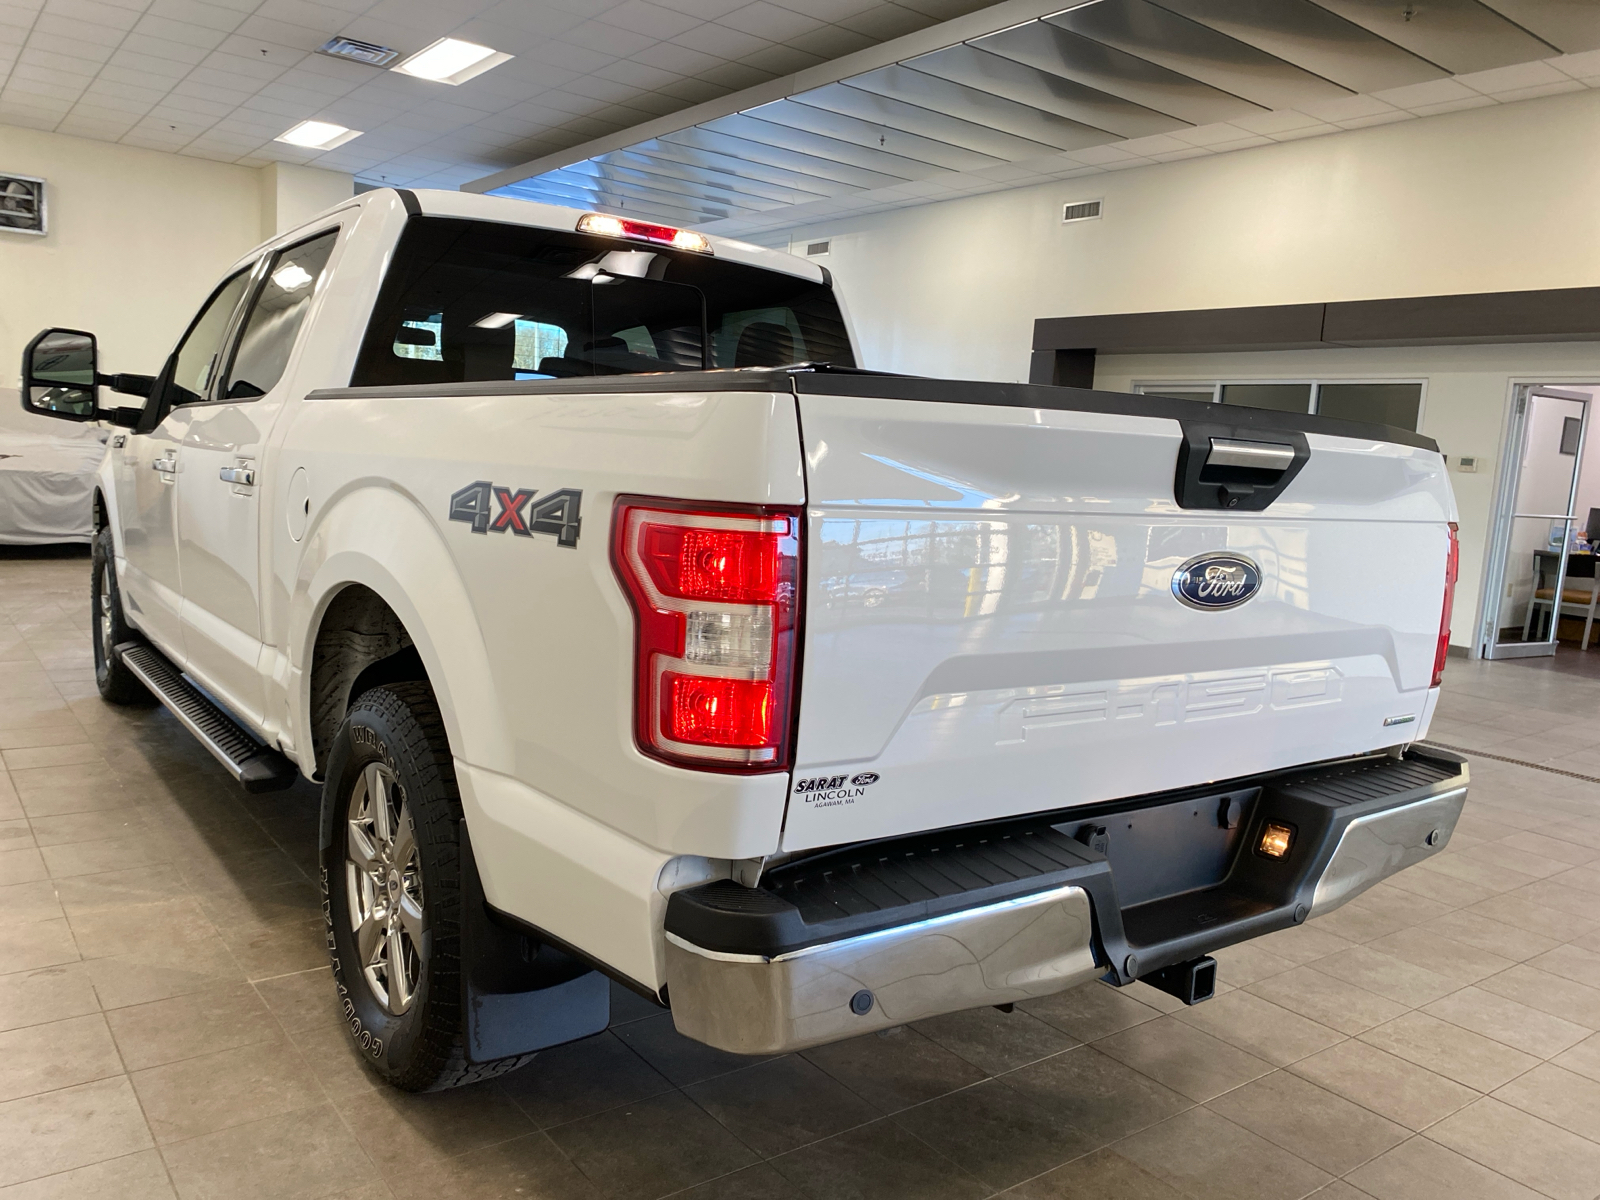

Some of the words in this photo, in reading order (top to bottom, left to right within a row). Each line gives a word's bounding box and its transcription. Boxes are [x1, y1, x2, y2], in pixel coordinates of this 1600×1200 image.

[1197, 565, 1247, 597] Ford
[994, 664, 1345, 746] F-150
[794, 774, 850, 794] SARAT
[854, 773, 878, 786] Ford
[805, 787, 865, 803] LINCOLN
[813, 800, 844, 808] AGAWAM,
